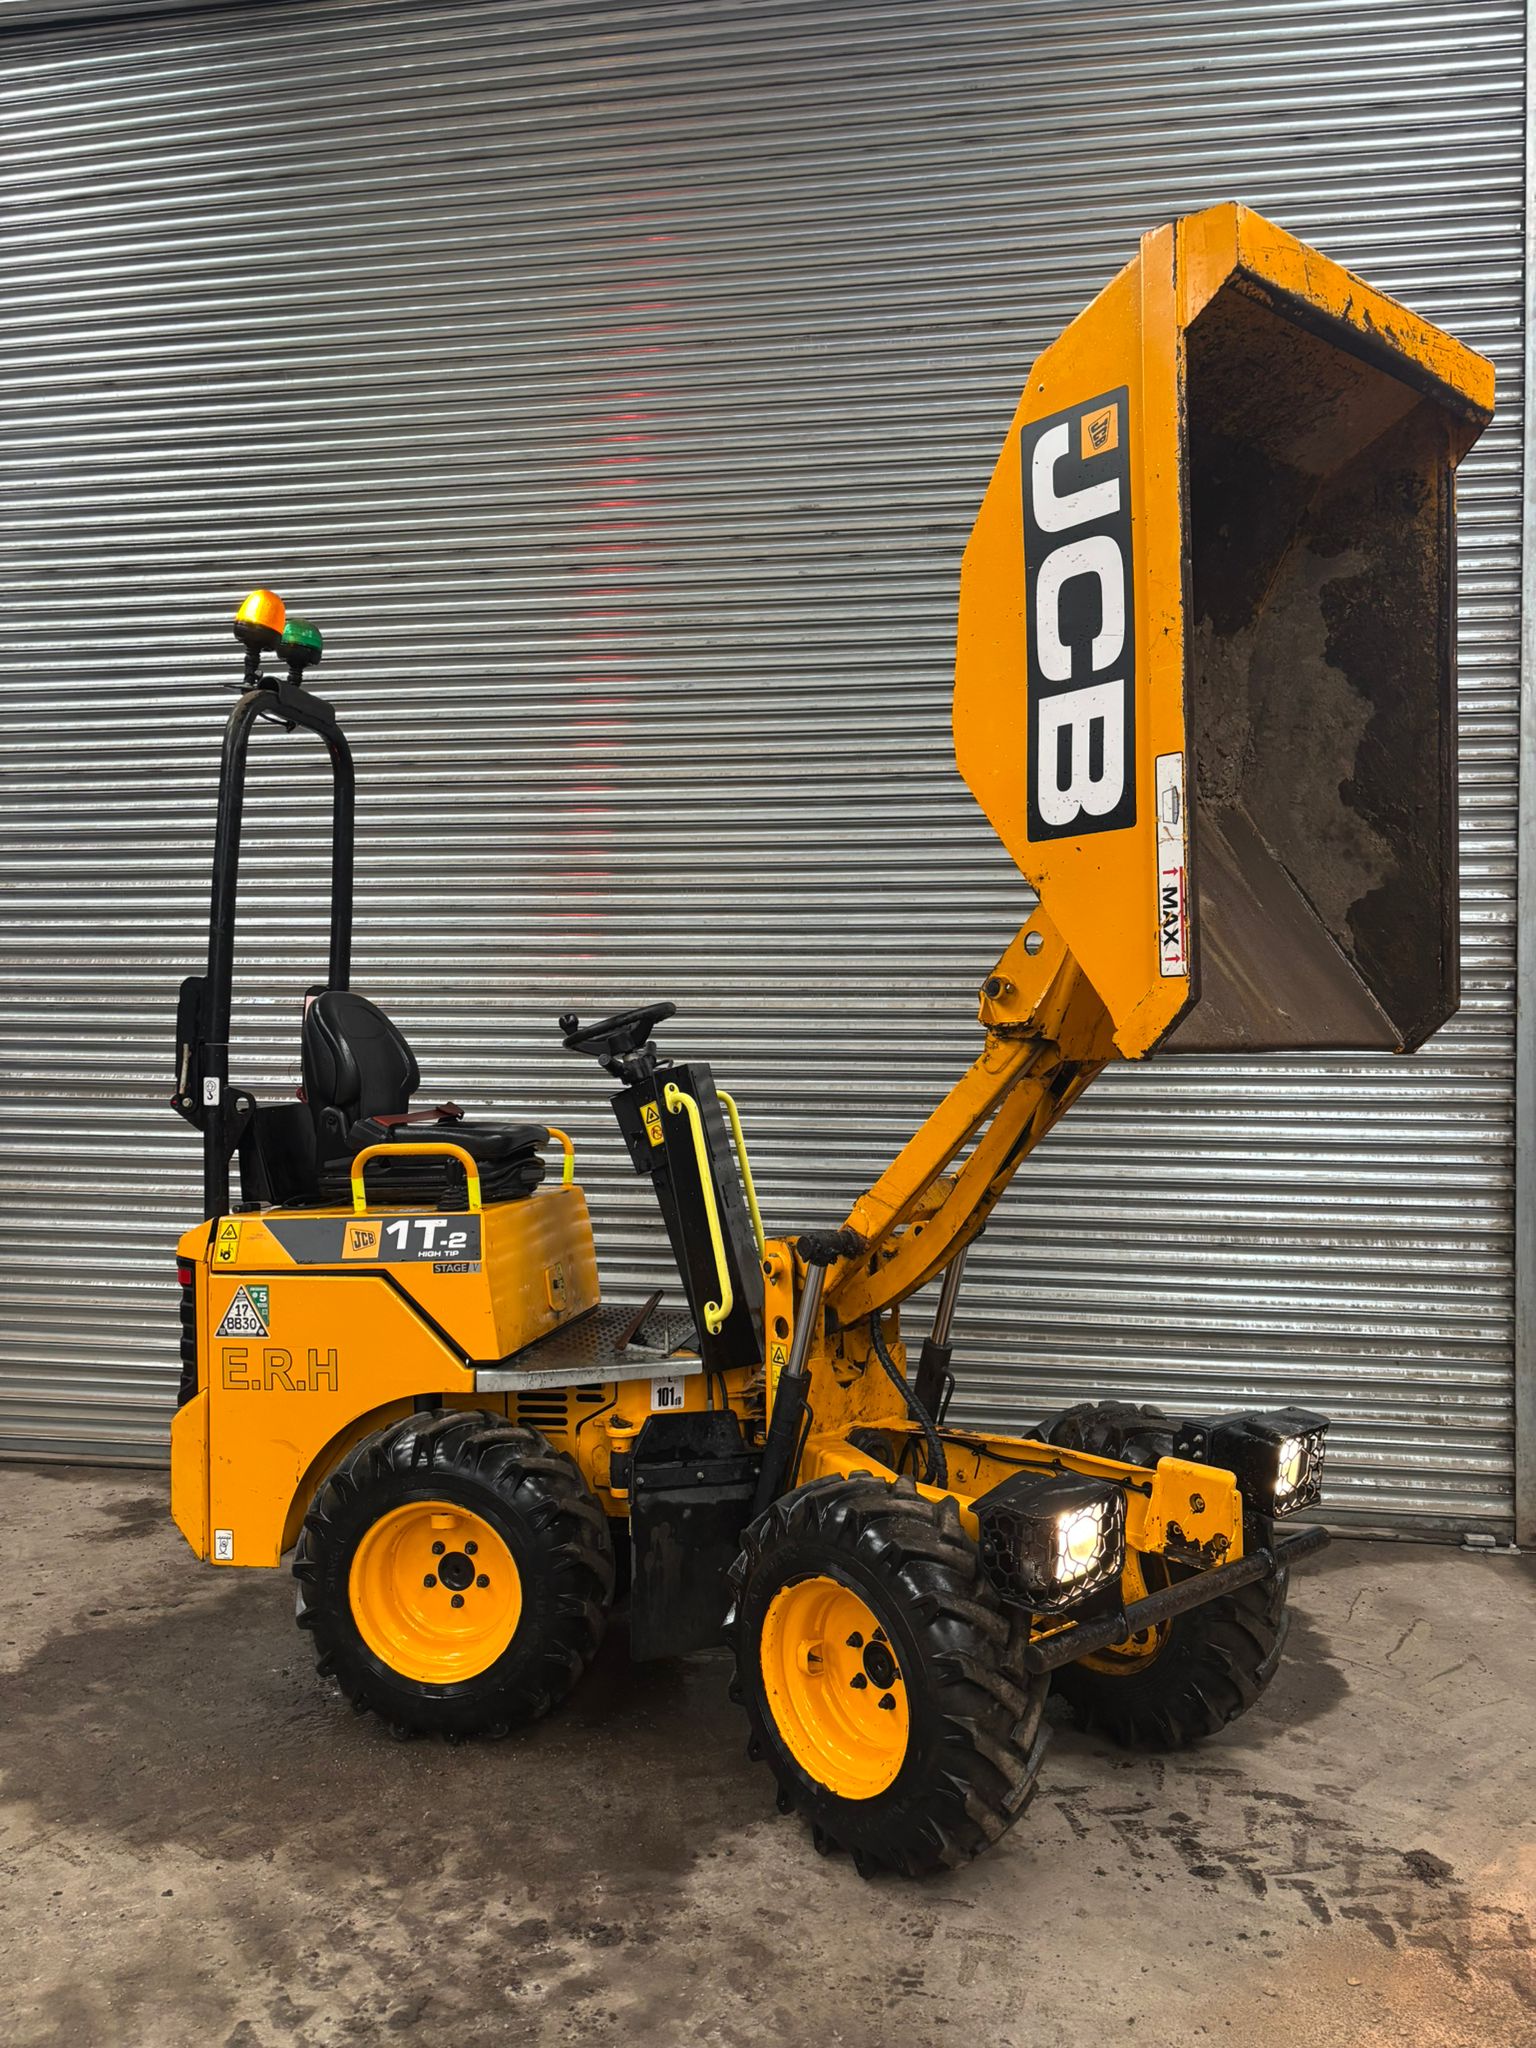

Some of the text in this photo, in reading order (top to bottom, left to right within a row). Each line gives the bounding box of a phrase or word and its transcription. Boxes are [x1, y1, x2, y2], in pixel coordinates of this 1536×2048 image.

[1090, 418, 1109, 447] JCB
[1032, 422, 1125, 827] JCB
[1162, 886, 1180, 946] MAX
[353, 1230, 375, 1250] JCB
[434, 1264, 467, 1273] STAGE
[259, 1291, 267, 1302] 5
[235, 1304, 249, 1317] 17
[222, 1347, 338, 1391] E.R.H
[657, 1386, 674, 1407] 101
